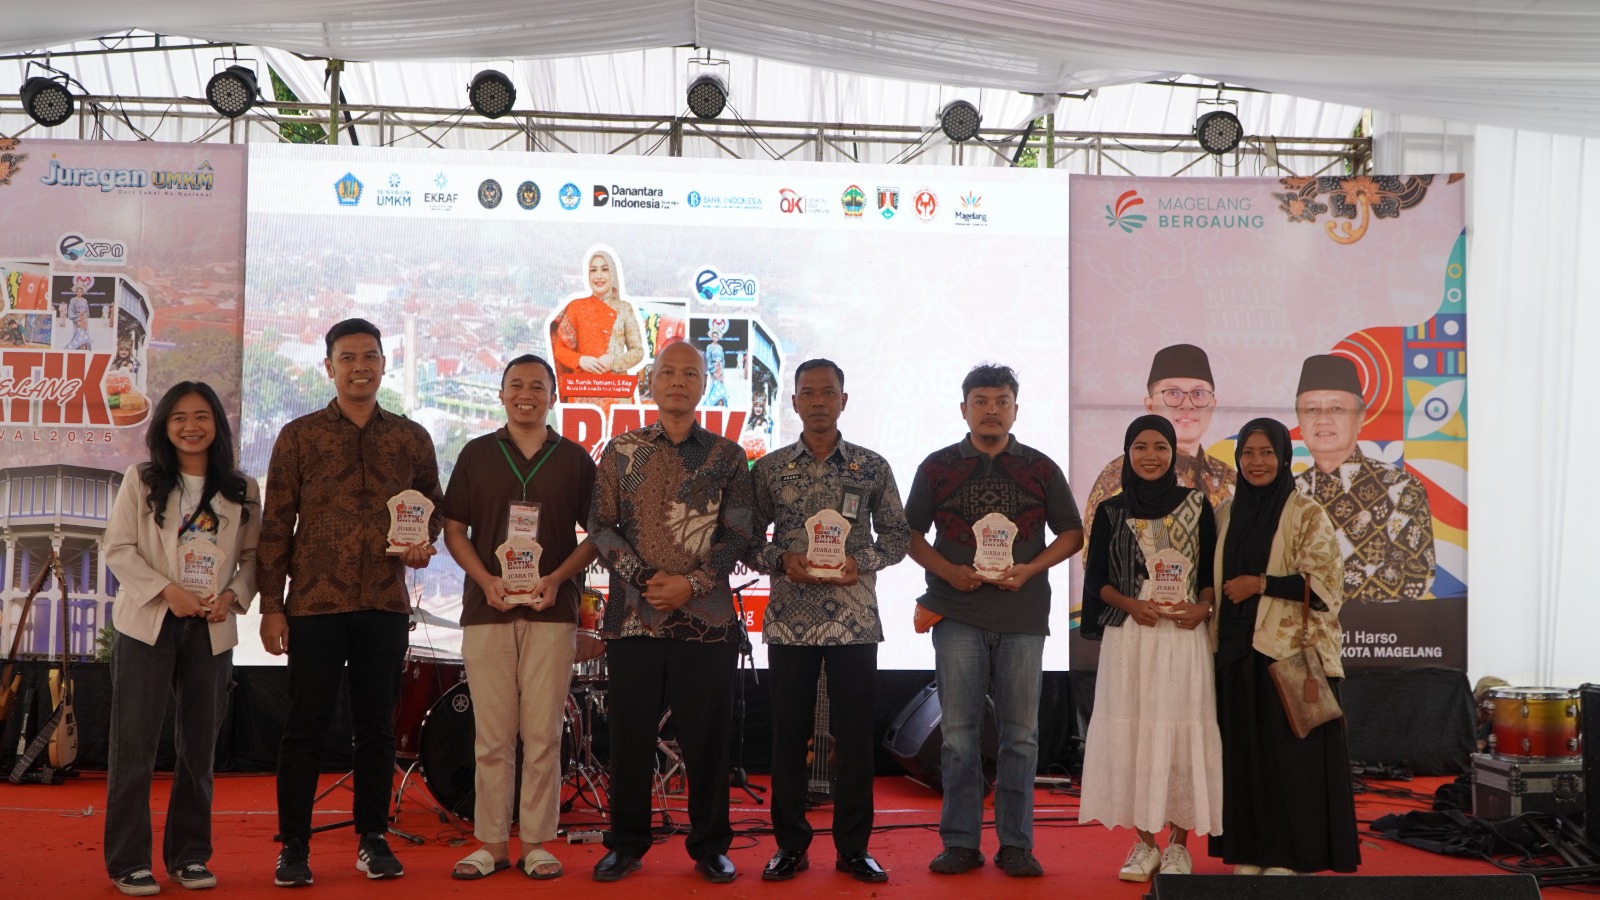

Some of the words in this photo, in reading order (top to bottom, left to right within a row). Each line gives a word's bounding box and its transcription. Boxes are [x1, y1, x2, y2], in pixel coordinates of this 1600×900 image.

[40, 158, 147, 192] Juragan
[152, 171, 214, 191] UMKM
[611, 185, 663, 197] Danantara
[377, 195, 411, 207] UMKM
[424, 193, 458, 204] EKRAF
[611, 197, 660, 209] Indonesia
[703, 196, 721, 204] BANK
[1158, 198, 1251, 211] MAGELANG
[955, 211, 987, 222] Magelang
[1159, 215, 1264, 228] BERGAUNG
[0, 351, 112, 425] TIK
[1355, 631, 1398, 644] Harso
[1339, 647, 1371, 658] KOTA
[1374, 647, 1442, 658] MAGELANG
